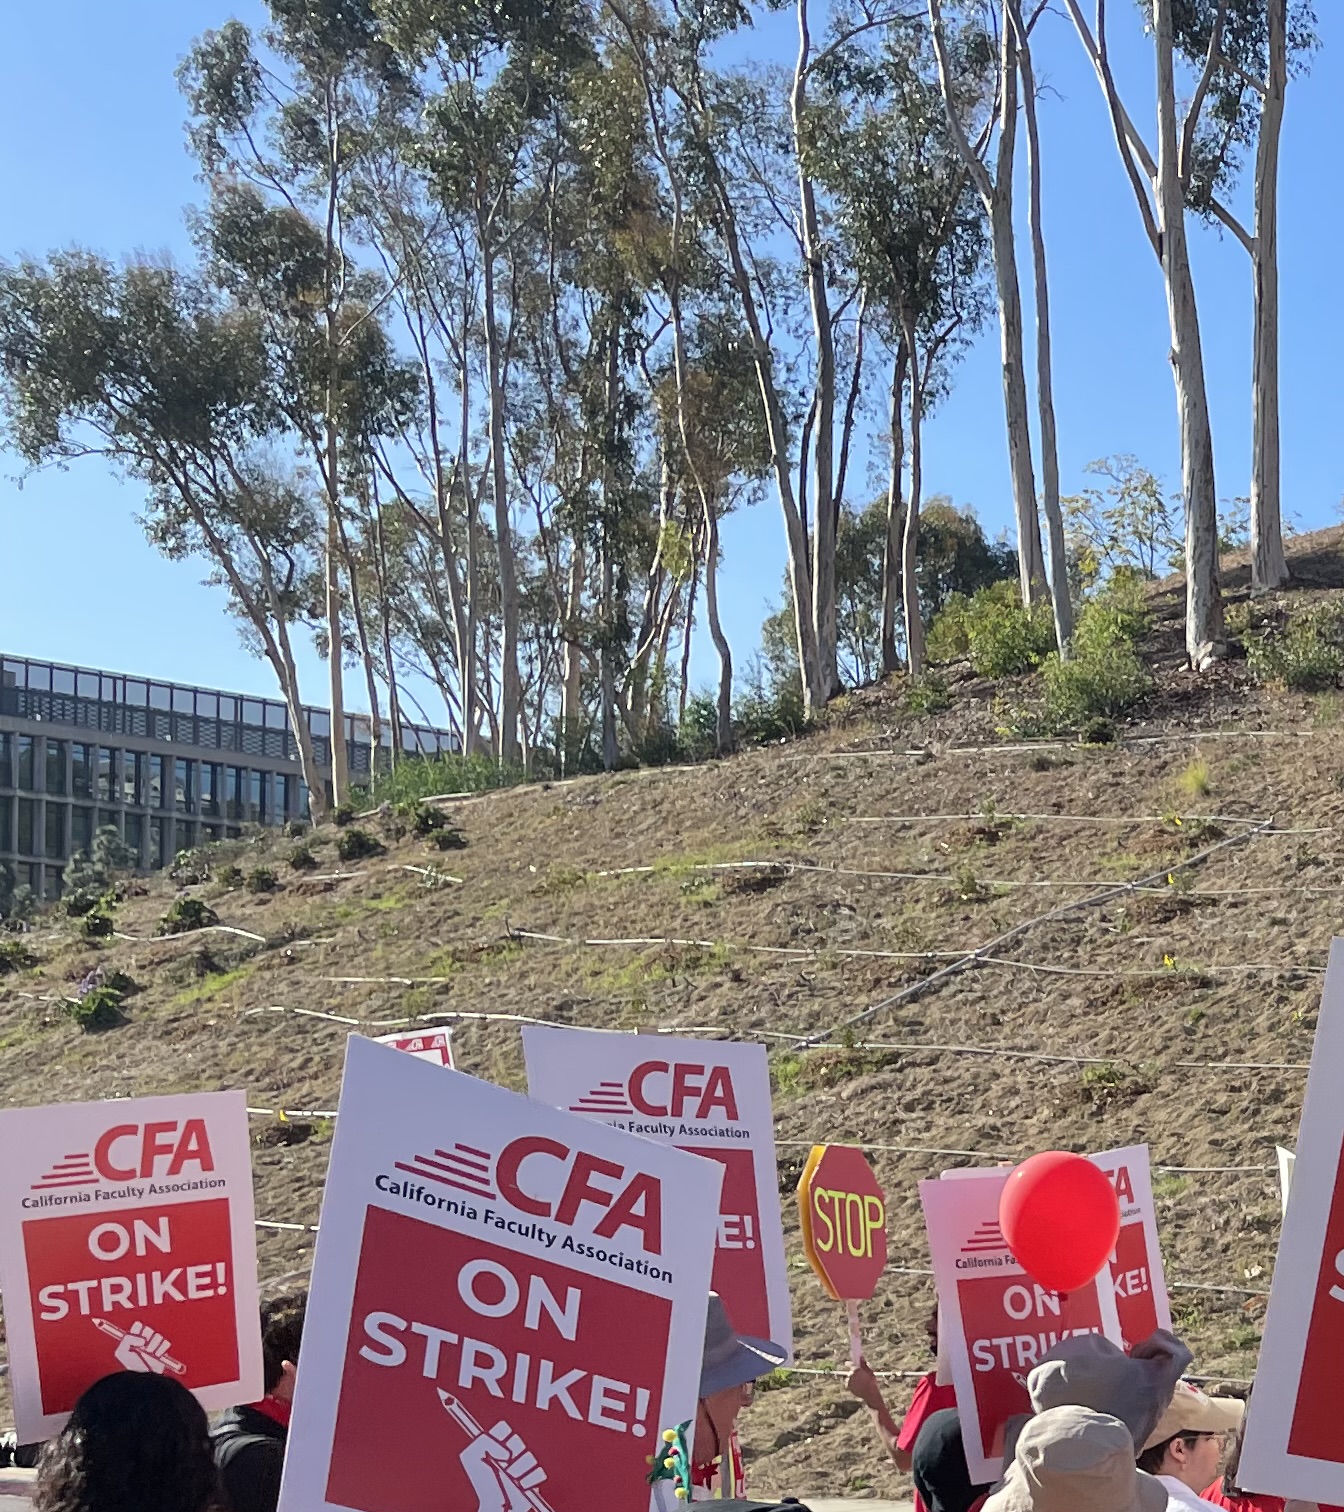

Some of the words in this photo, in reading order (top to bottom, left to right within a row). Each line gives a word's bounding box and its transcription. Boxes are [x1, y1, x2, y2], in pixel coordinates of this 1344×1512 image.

[628, 1060, 739, 1121] CFA
[94, 1118, 214, 1182] CFA
[628, 1121, 675, 1137] Faculty
[679, 1123, 750, 1140] Association
[21, 1191, 91, 1209] California
[94, 1186, 145, 1202] Faculty
[149, 1178, 226, 1195] Association
[496, 1136, 662, 1255] CFA
[813, 1187, 885, 1258] STOP
[88, 1216, 172, 1261] ON
[374, 1174, 478, 1221] California
[483, 1208, 557, 1248] Faculty
[561, 1235, 673, 1283] Association
[38, 1262, 228, 1321] STRIKE!
[955, 1255, 1003, 1270] California
[457, 1258, 582, 1341] ON
[1003, 1284, 1061, 1321] ON
[358, 1311, 651, 1438] STRIKE!
[972, 1326, 1101, 1373] STRI
